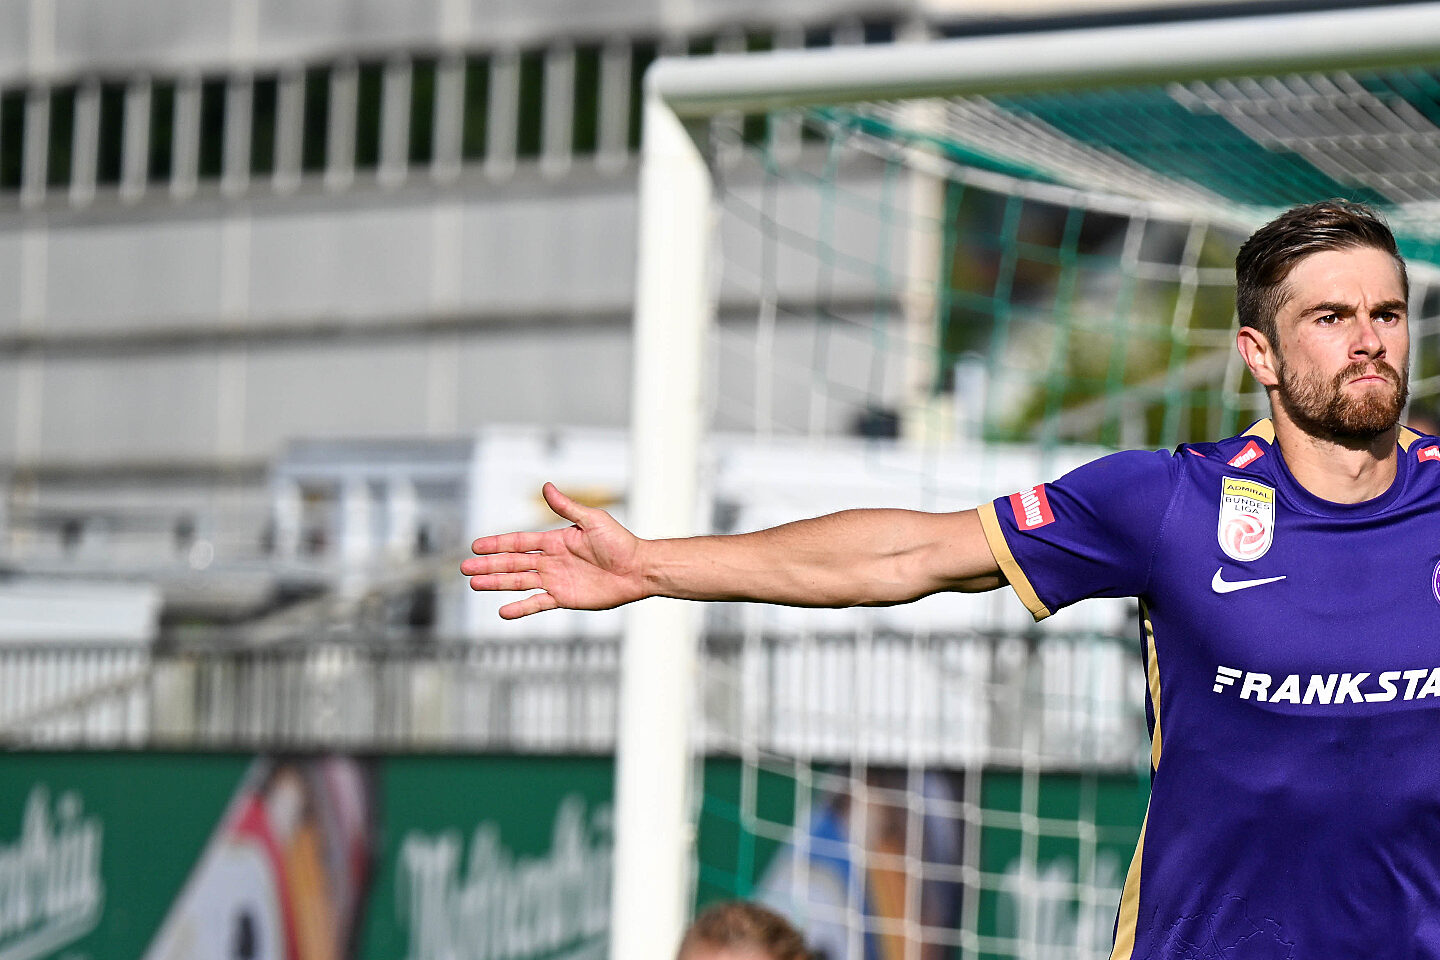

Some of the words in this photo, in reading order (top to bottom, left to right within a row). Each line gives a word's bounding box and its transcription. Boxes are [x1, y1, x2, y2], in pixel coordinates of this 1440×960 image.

[1227, 485, 1270, 499] ADMIRAL
[1225, 497, 1270, 510] BUNDES
[1235, 505, 1259, 514] LIGA
